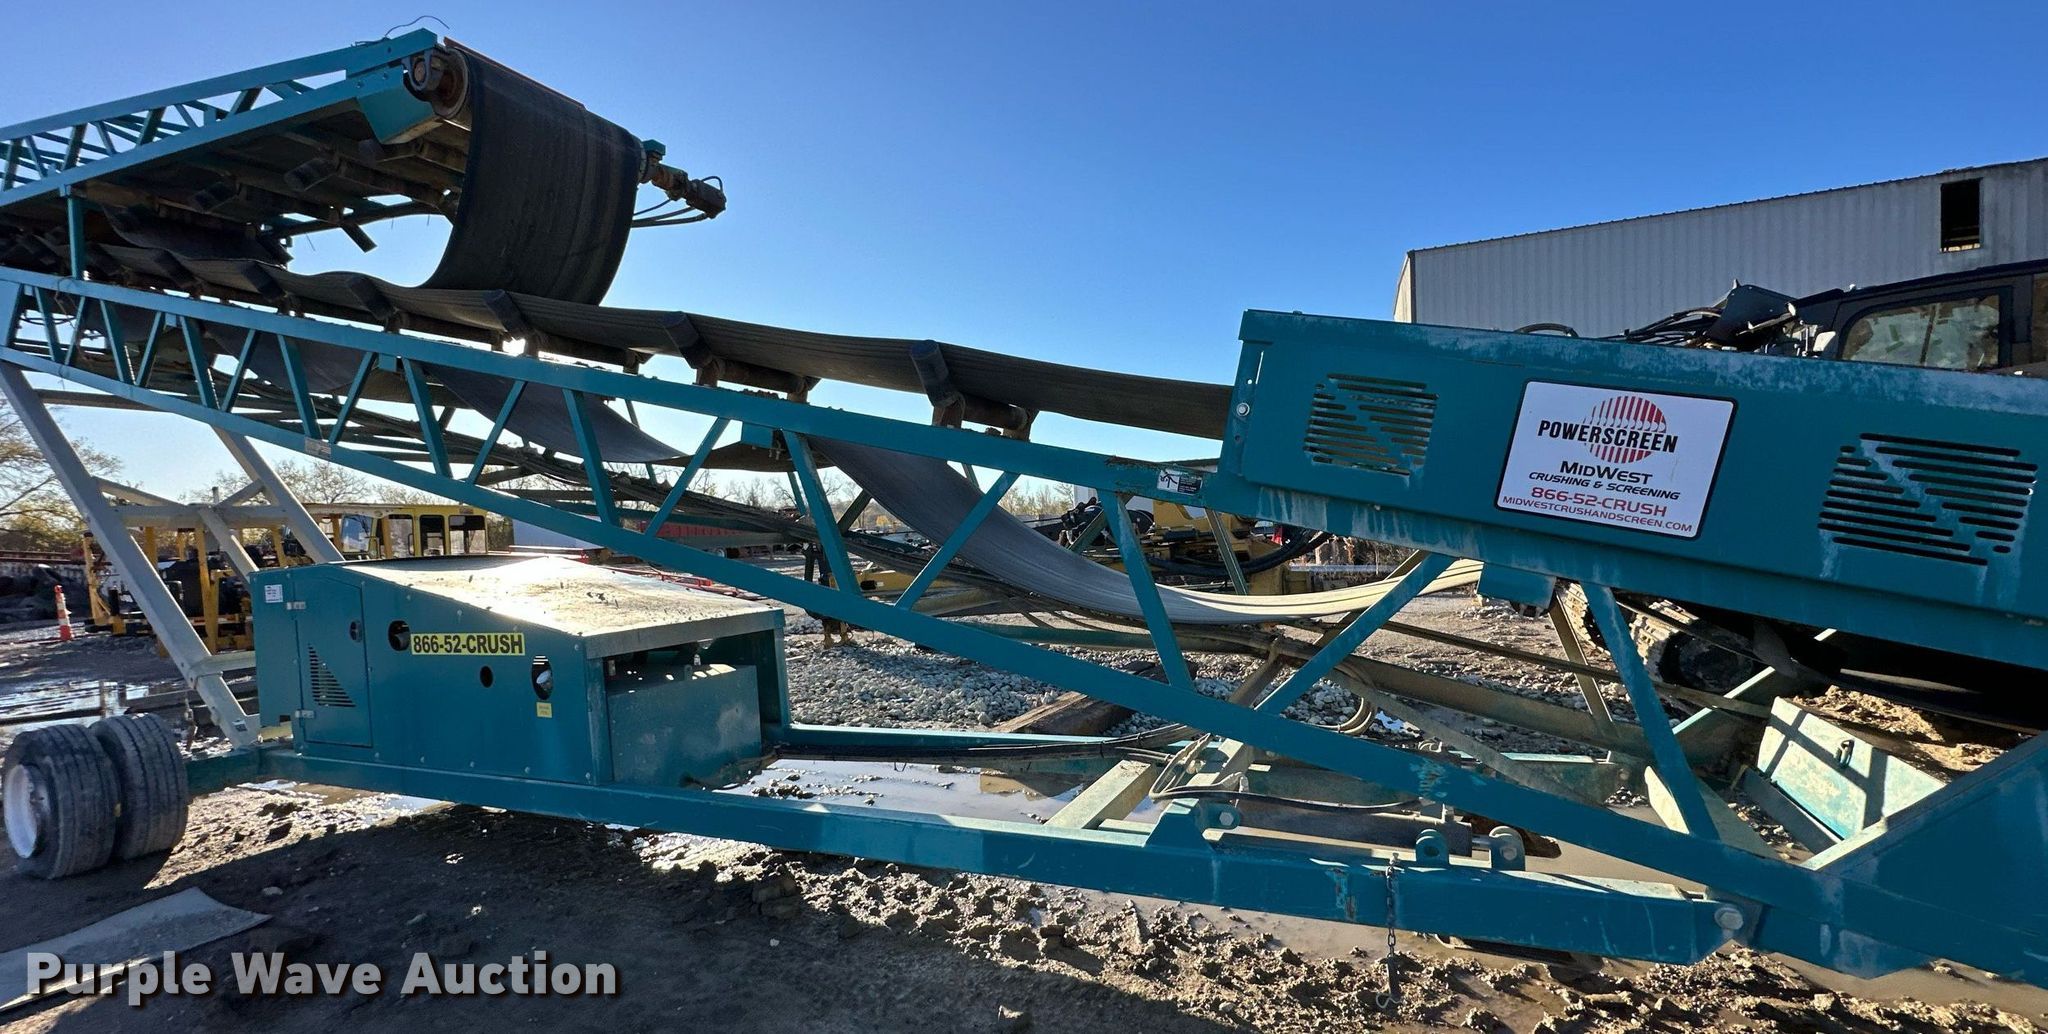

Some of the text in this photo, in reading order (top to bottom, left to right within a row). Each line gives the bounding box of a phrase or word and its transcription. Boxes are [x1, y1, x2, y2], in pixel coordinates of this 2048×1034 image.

[1537, 419, 1679, 453] POWERSCREEN
[1528, 471, 1681, 500] CRUSHING & SCREENING
[1503, 495, 1693, 532] MIDWESTCRUSHANDSCREEN.COM
[1531, 486, 1667, 517] 866-52-CRUSH
[413, 634, 523, 654] 866-52-CRUSH
